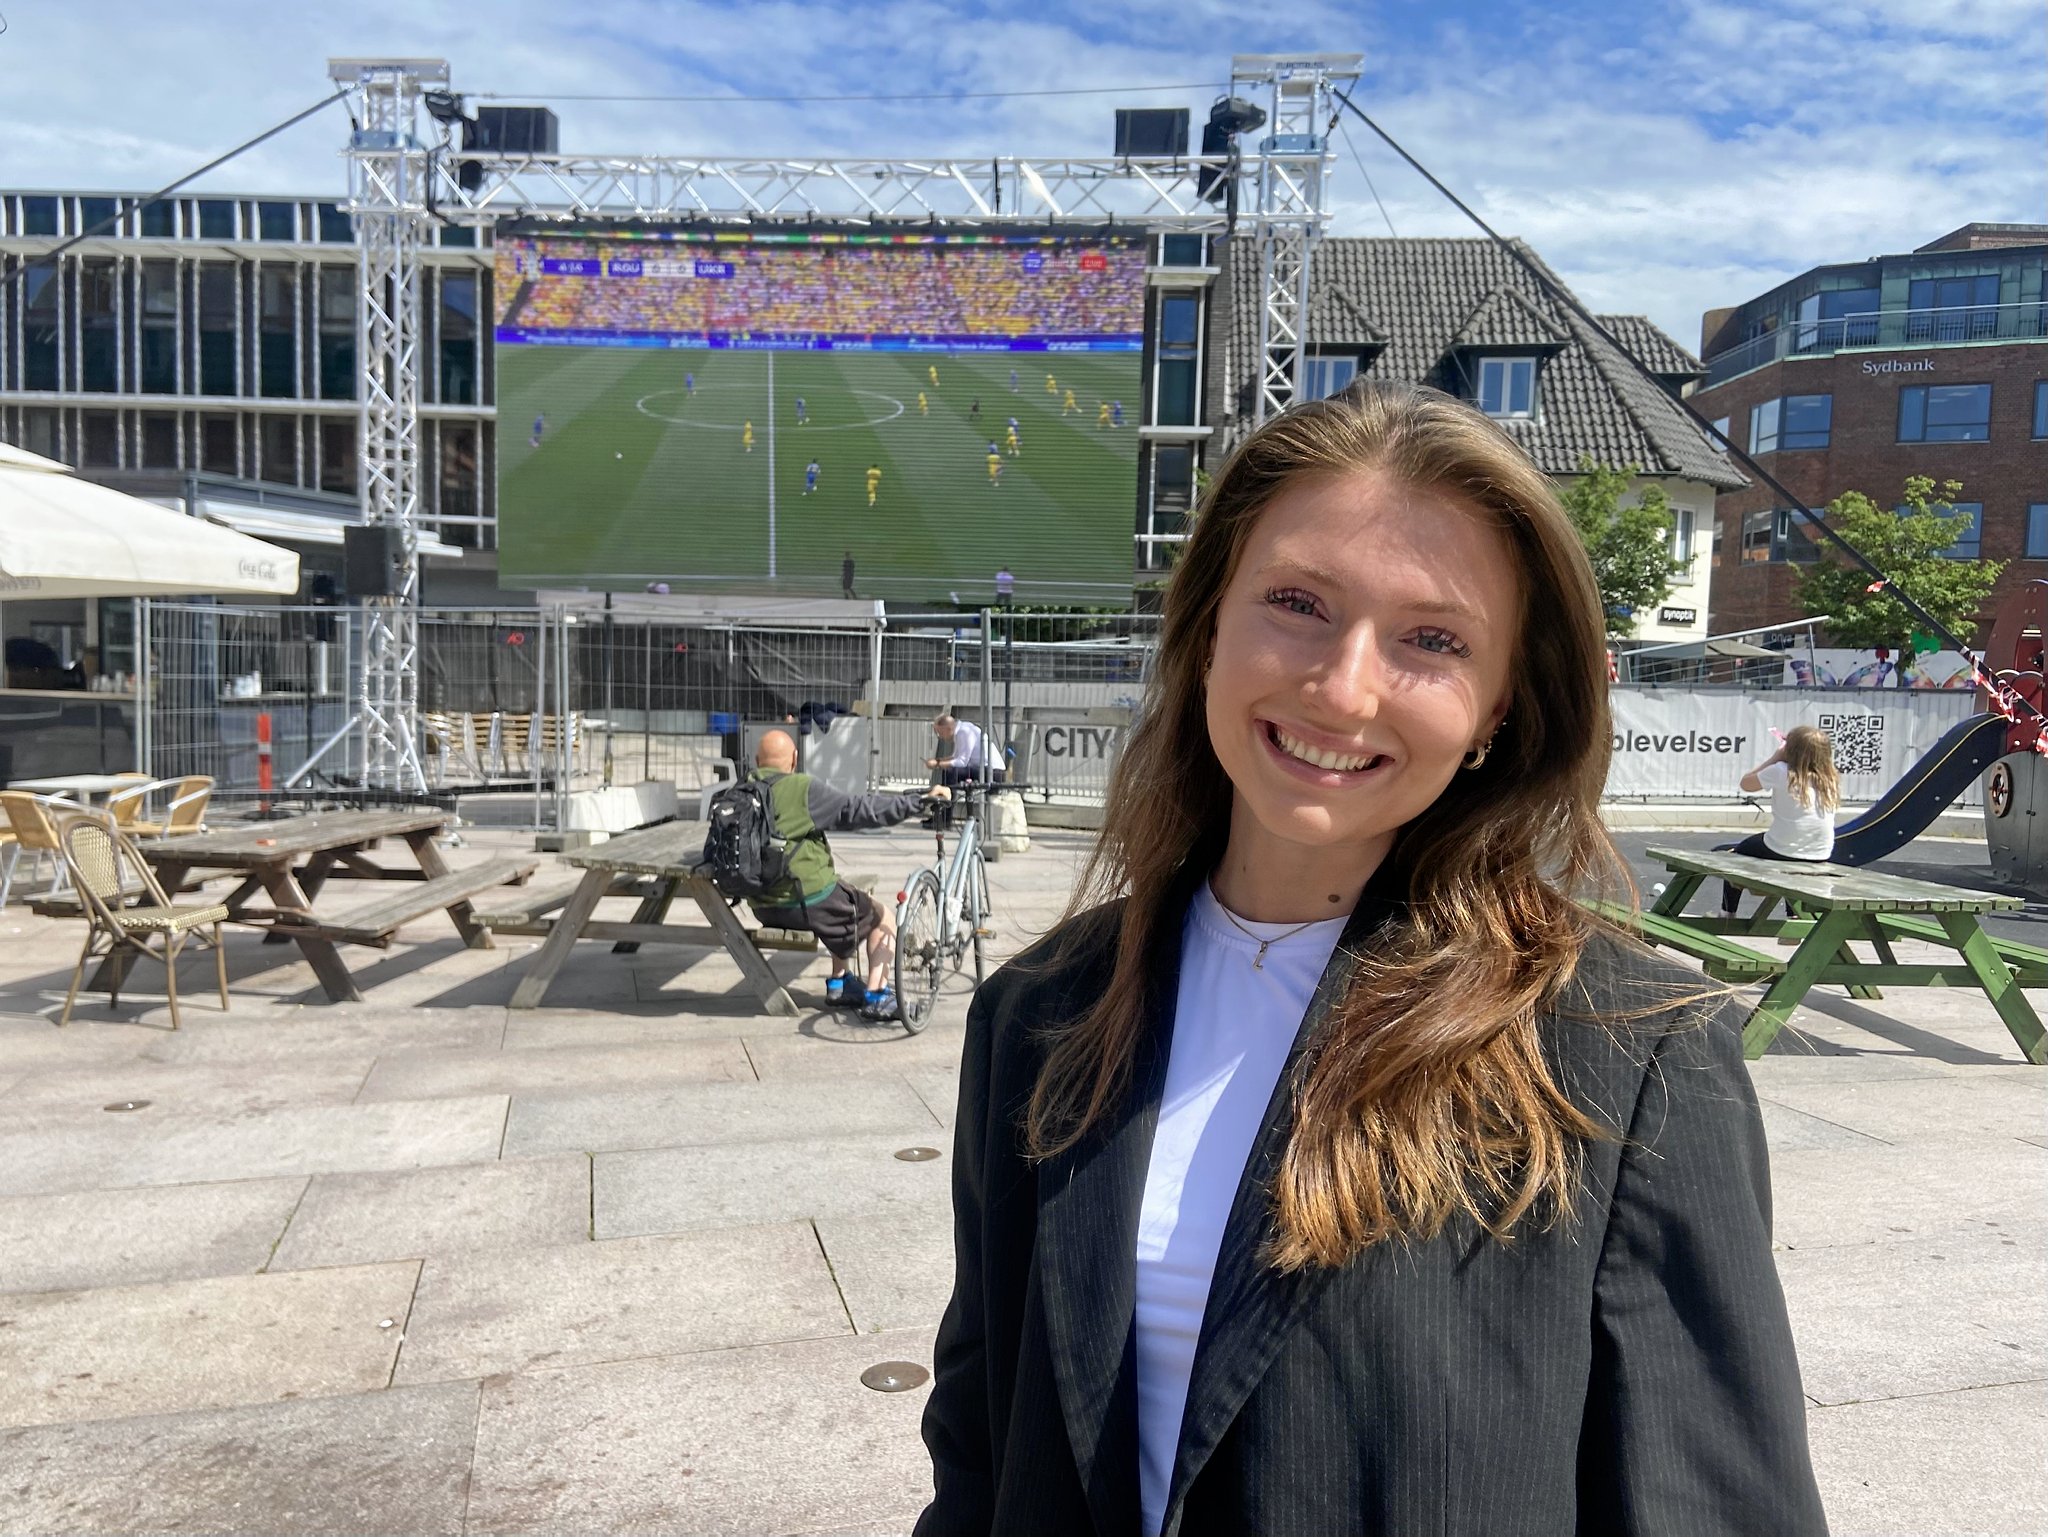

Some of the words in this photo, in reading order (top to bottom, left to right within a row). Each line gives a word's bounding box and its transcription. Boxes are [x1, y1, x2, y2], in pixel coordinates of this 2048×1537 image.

[1862, 358, 1935, 376] Sydbank
[1663, 609, 1694, 621] synoptik
[1045, 727, 1112, 759] CITY
